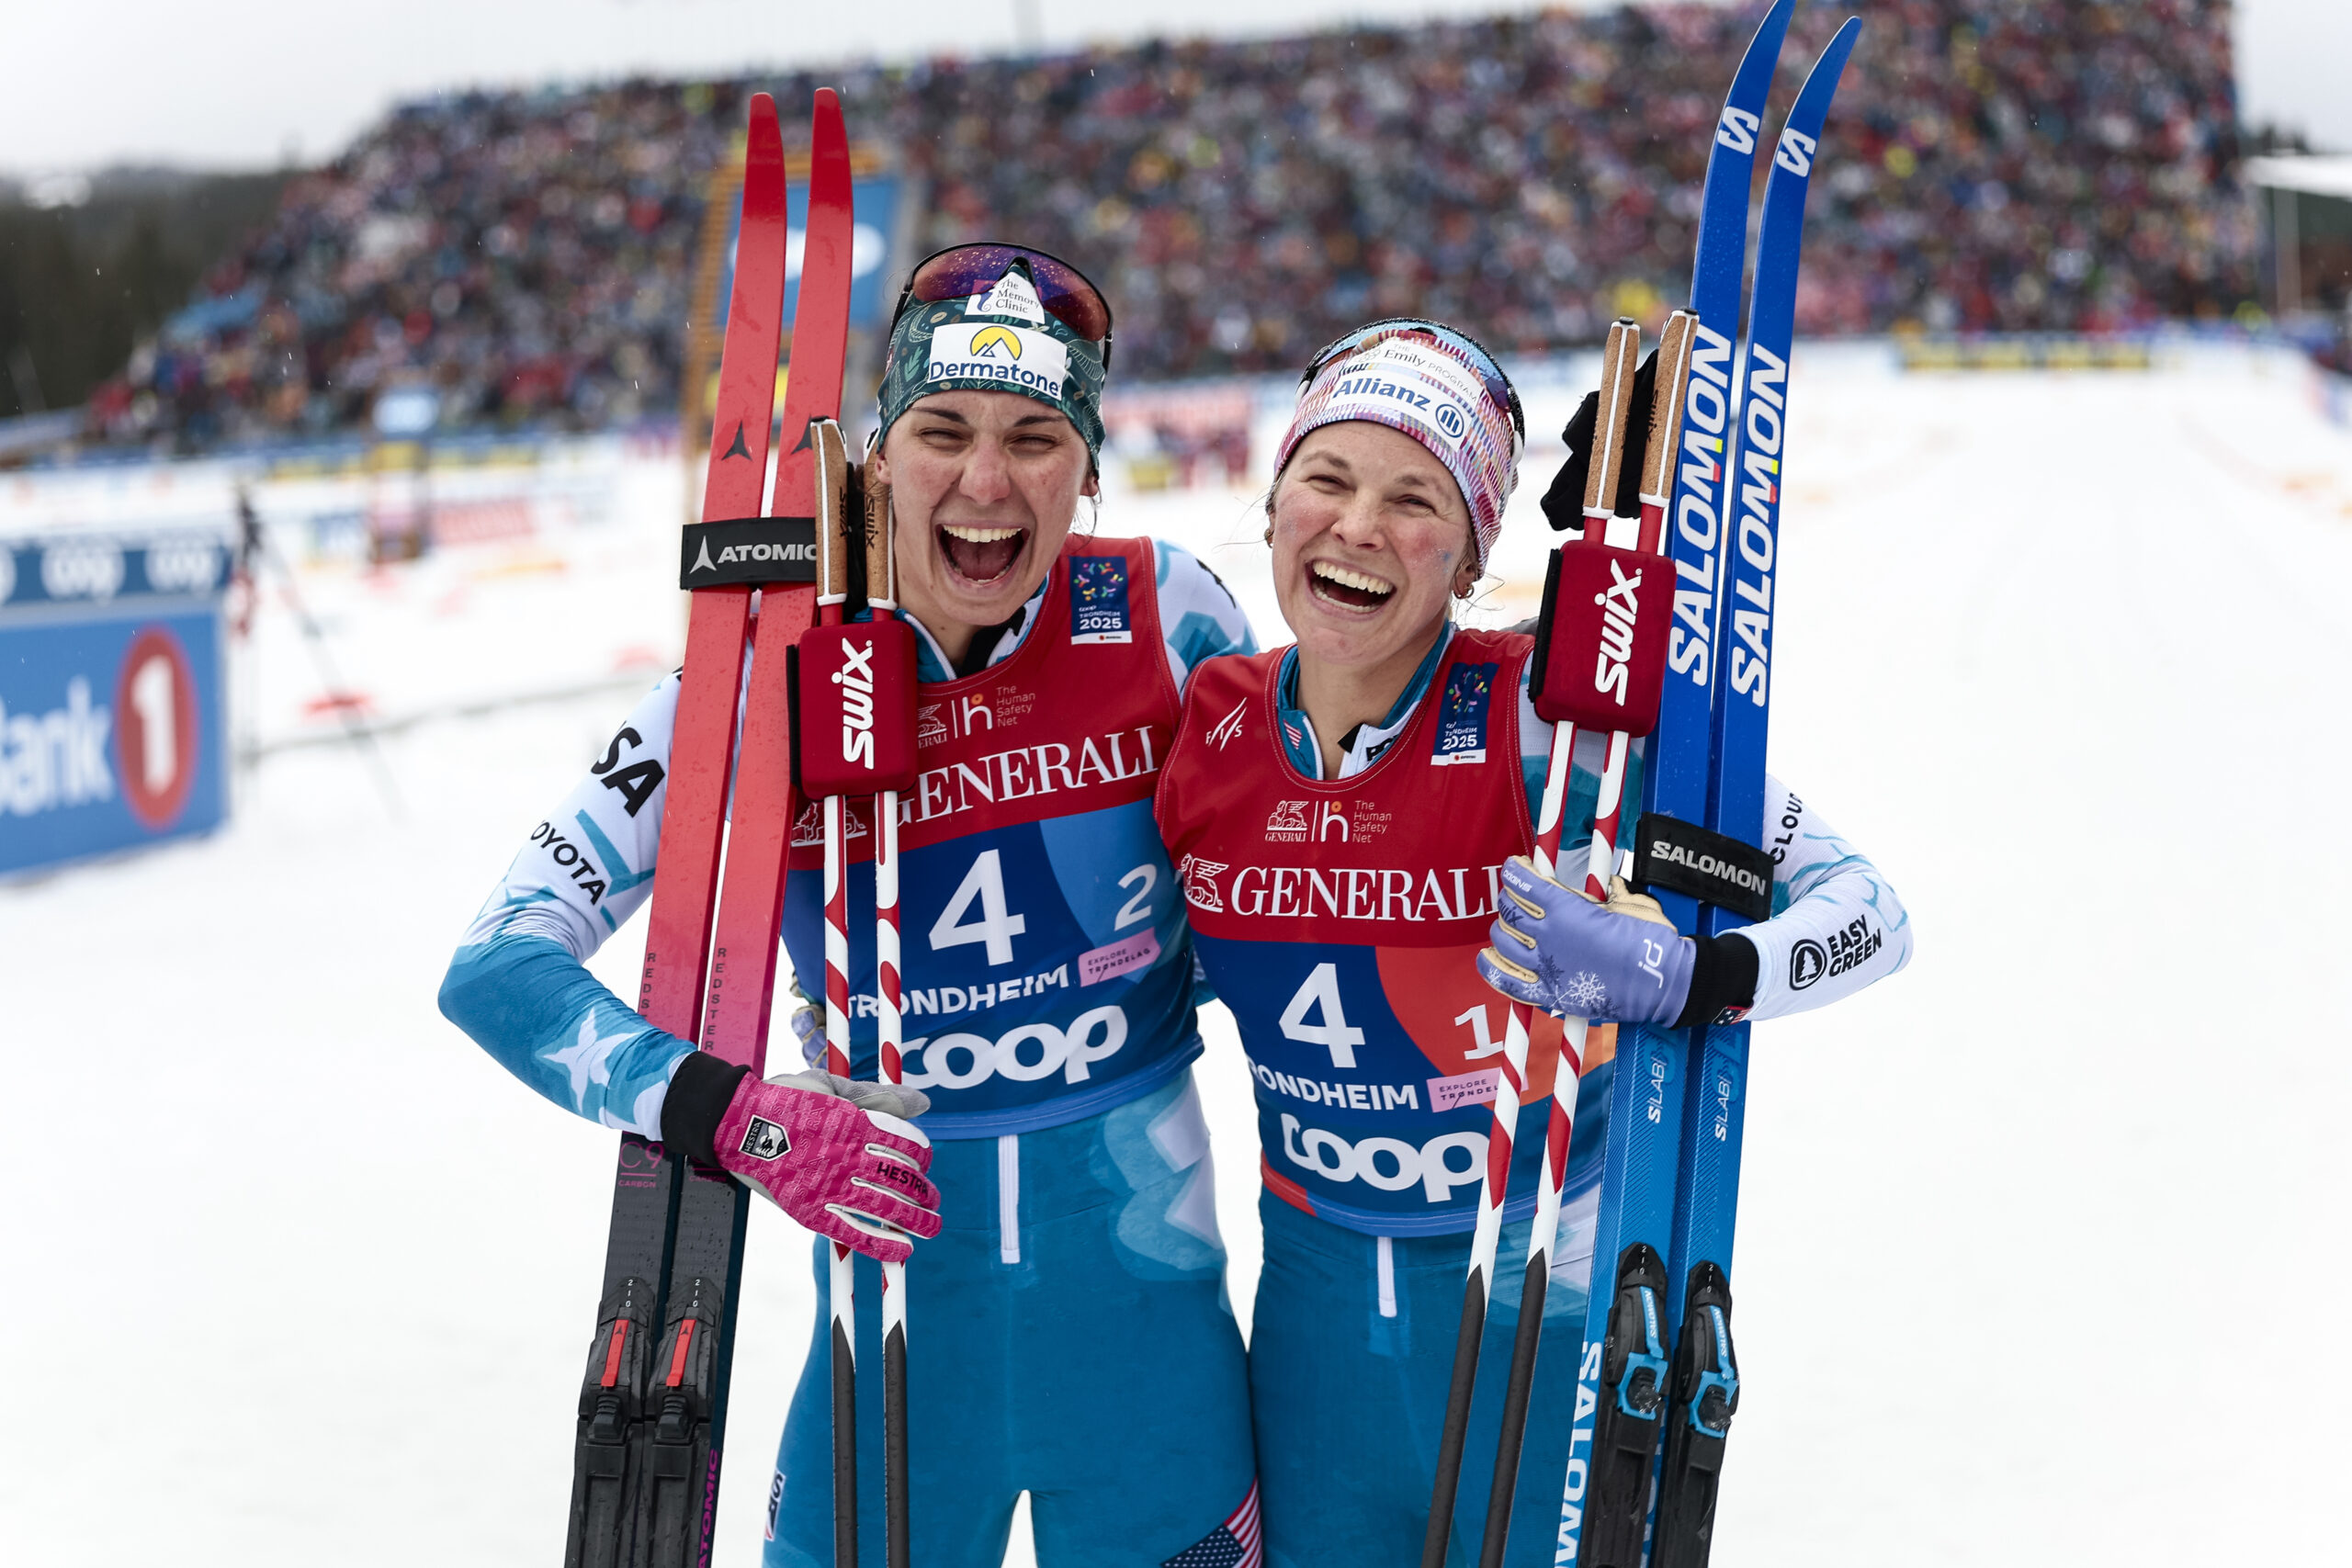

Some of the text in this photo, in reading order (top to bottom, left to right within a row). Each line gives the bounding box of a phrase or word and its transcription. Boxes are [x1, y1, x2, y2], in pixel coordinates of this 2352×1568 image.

[997, 288, 1039, 309] Memory
[1001, 278, 1019, 289] The
[995, 299, 1028, 313] Clinic
[930, 361, 1059, 397] Dermatone
[1385, 349, 1477, 402] Emily PROGRAM
[1332, 378, 1431, 412] Allianz
[1668, 323, 1732, 687] SALOMON
[1731, 342, 1787, 708] SALOMON
[718, 544, 817, 564] ATOMIC
[1080, 617, 1122, 630] 2025
[996, 685, 1017, 696] The
[996, 692, 1036, 706] Human
[130, 654, 177, 798] 1
[996, 703, 1034, 718] Safety
[996, 716, 1019, 728] Net
[0, 675, 112, 816] ank
[919, 733, 947, 749] ERALI
[591, 721, 665, 818] SA
[1353, 811, 1392, 822] Human
[1354, 800, 1375, 810] The
[1264, 831, 1306, 842] GENERALI
[1352, 821, 1388, 834] Safety
[1352, 833, 1372, 843] Net
[530, 820, 606, 905] OYOTA
[1650, 840, 1766, 897] SALOMON
[928, 849, 1026, 966] 4
[1114, 863, 1158, 931] 2
[1231, 864, 1504, 921] GENERALI
[1826, 914, 1869, 955] EASY
[1088, 948, 1127, 965] EXPLORE
[1828, 929, 1883, 977] GREEN
[641, 953, 656, 1019] REDS
[705, 948, 727, 1051] REDSTER
[1278, 963, 1365, 1068] 4
[1454, 1004, 1504, 1060] 1
[900, 1005, 1128, 1089] coop
[1439, 1078, 1487, 1093] EXPLORE
[1440, 1085, 1498, 1100] TRØNDEL
[619, 1141, 665, 1168] C9
[744, 1122, 763, 1152] HESTRA
[1281, 1113, 1490, 1203] coop
[618, 1179, 657, 1188] CARBON
[876, 1161, 930, 1198] HESTRA
[1555, 1341, 1602, 1568] SALOM
[698, 1449, 718, 1568] ATOMIC
